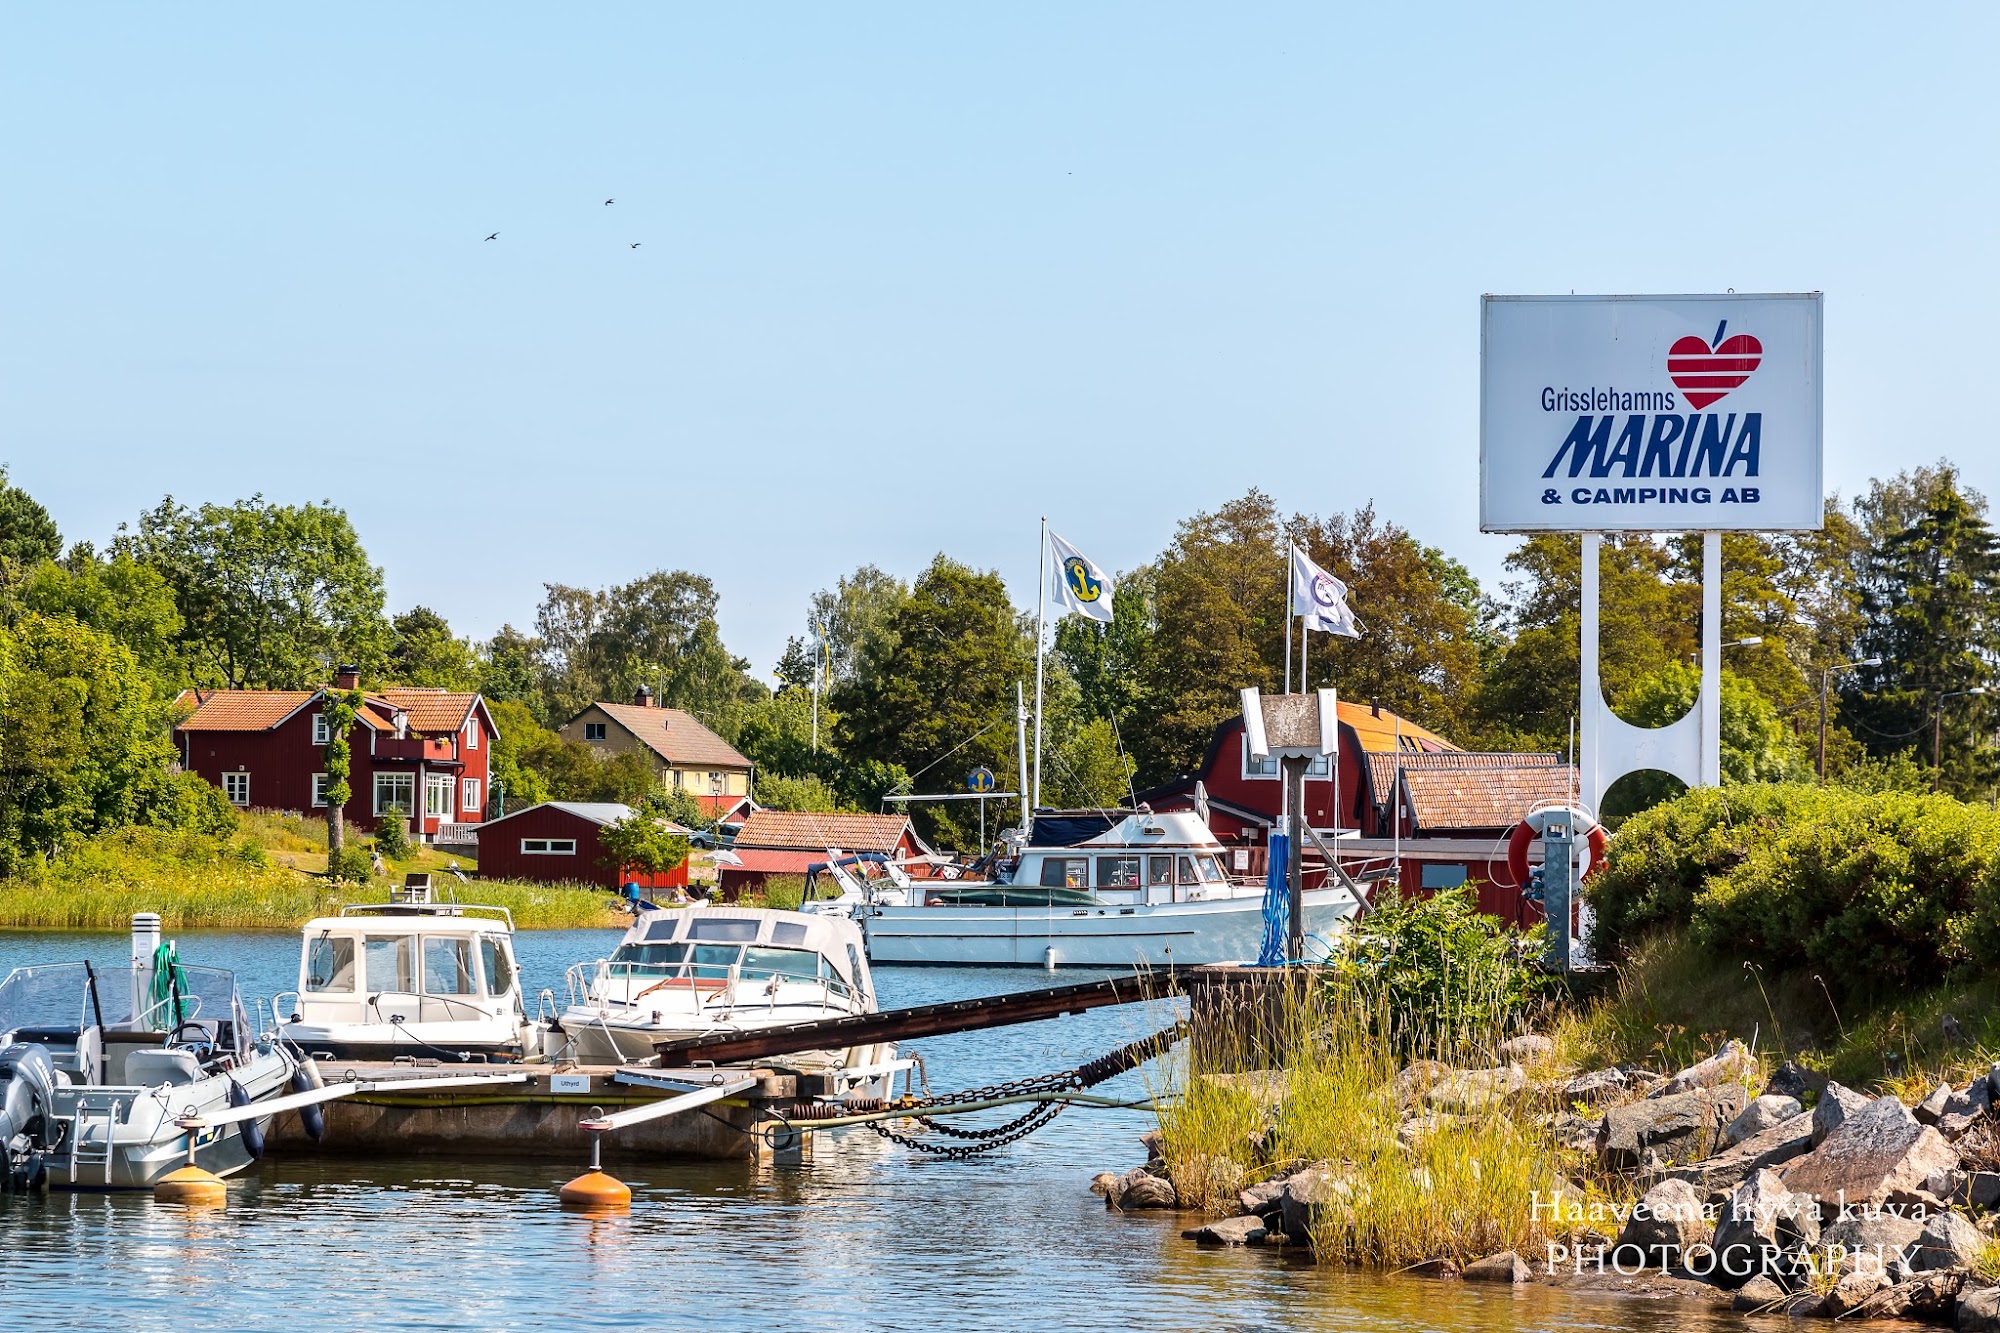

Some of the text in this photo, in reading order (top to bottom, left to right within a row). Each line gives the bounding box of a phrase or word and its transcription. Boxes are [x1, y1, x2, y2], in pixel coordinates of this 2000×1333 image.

[1542, 387, 1674, 411] Grisslehamns
[1542, 414, 1761, 478] MARINA
[1542, 488, 1760, 504] & CAMPING AB
